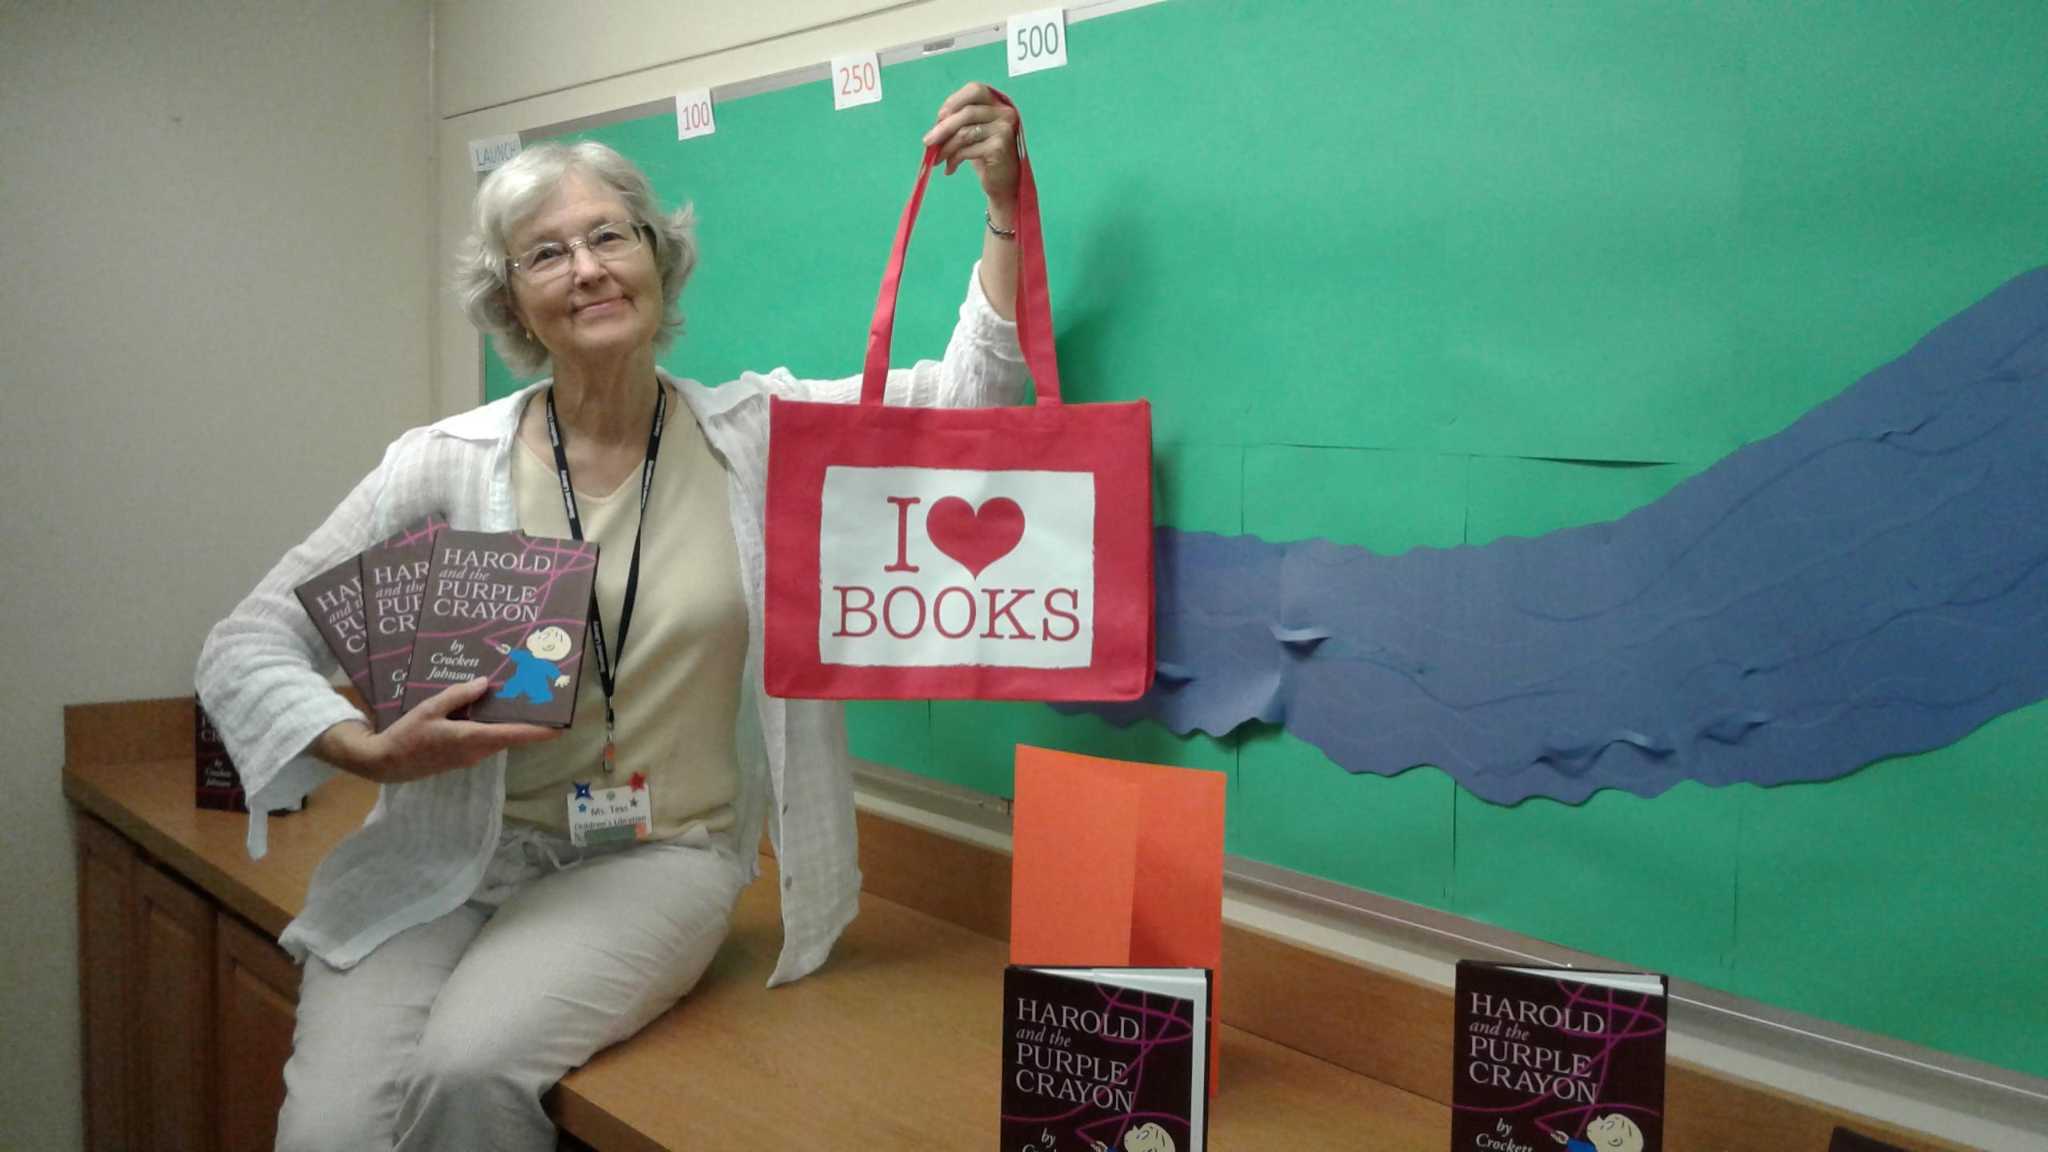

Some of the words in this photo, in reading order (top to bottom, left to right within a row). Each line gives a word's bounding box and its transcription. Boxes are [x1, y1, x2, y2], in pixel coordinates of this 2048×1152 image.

[1017, 22, 1059, 60] 500
[840, 62, 876, 95] 250
[682, 101, 711, 130] 100
[884, 496, 921, 572] I
[439, 565, 467, 579] and
[469, 567, 490, 581] the
[443, 548, 551, 573] HAROLD
[437, 580, 537, 603] PURPLE
[434, 598, 540, 622] CRAYON
[832, 586, 1080, 641] BOOKS
[431, 652, 479, 667] Crockett
[450, 640, 464, 655] by
[427, 667, 476, 681] Johnson
[1017, 998, 1140, 1040] HAROLD
[1471, 992, 1605, 1034] HAROLD
[1016, 1026, 1046, 1043] and
[1049, 1029, 1071, 1047] the
[1469, 1020, 1501, 1036] and
[1505, 1021, 1530, 1041] the
[1016, 1042, 1129, 1086] PURPLE
[1470, 1035, 1592, 1078] PURPLE
[1016, 1069, 1134, 1113] CRAYON
[1469, 1061, 1598, 1105] CRAYON
[1041, 1128, 1056, 1148] by
[1496, 1118, 1512, 1137] by
